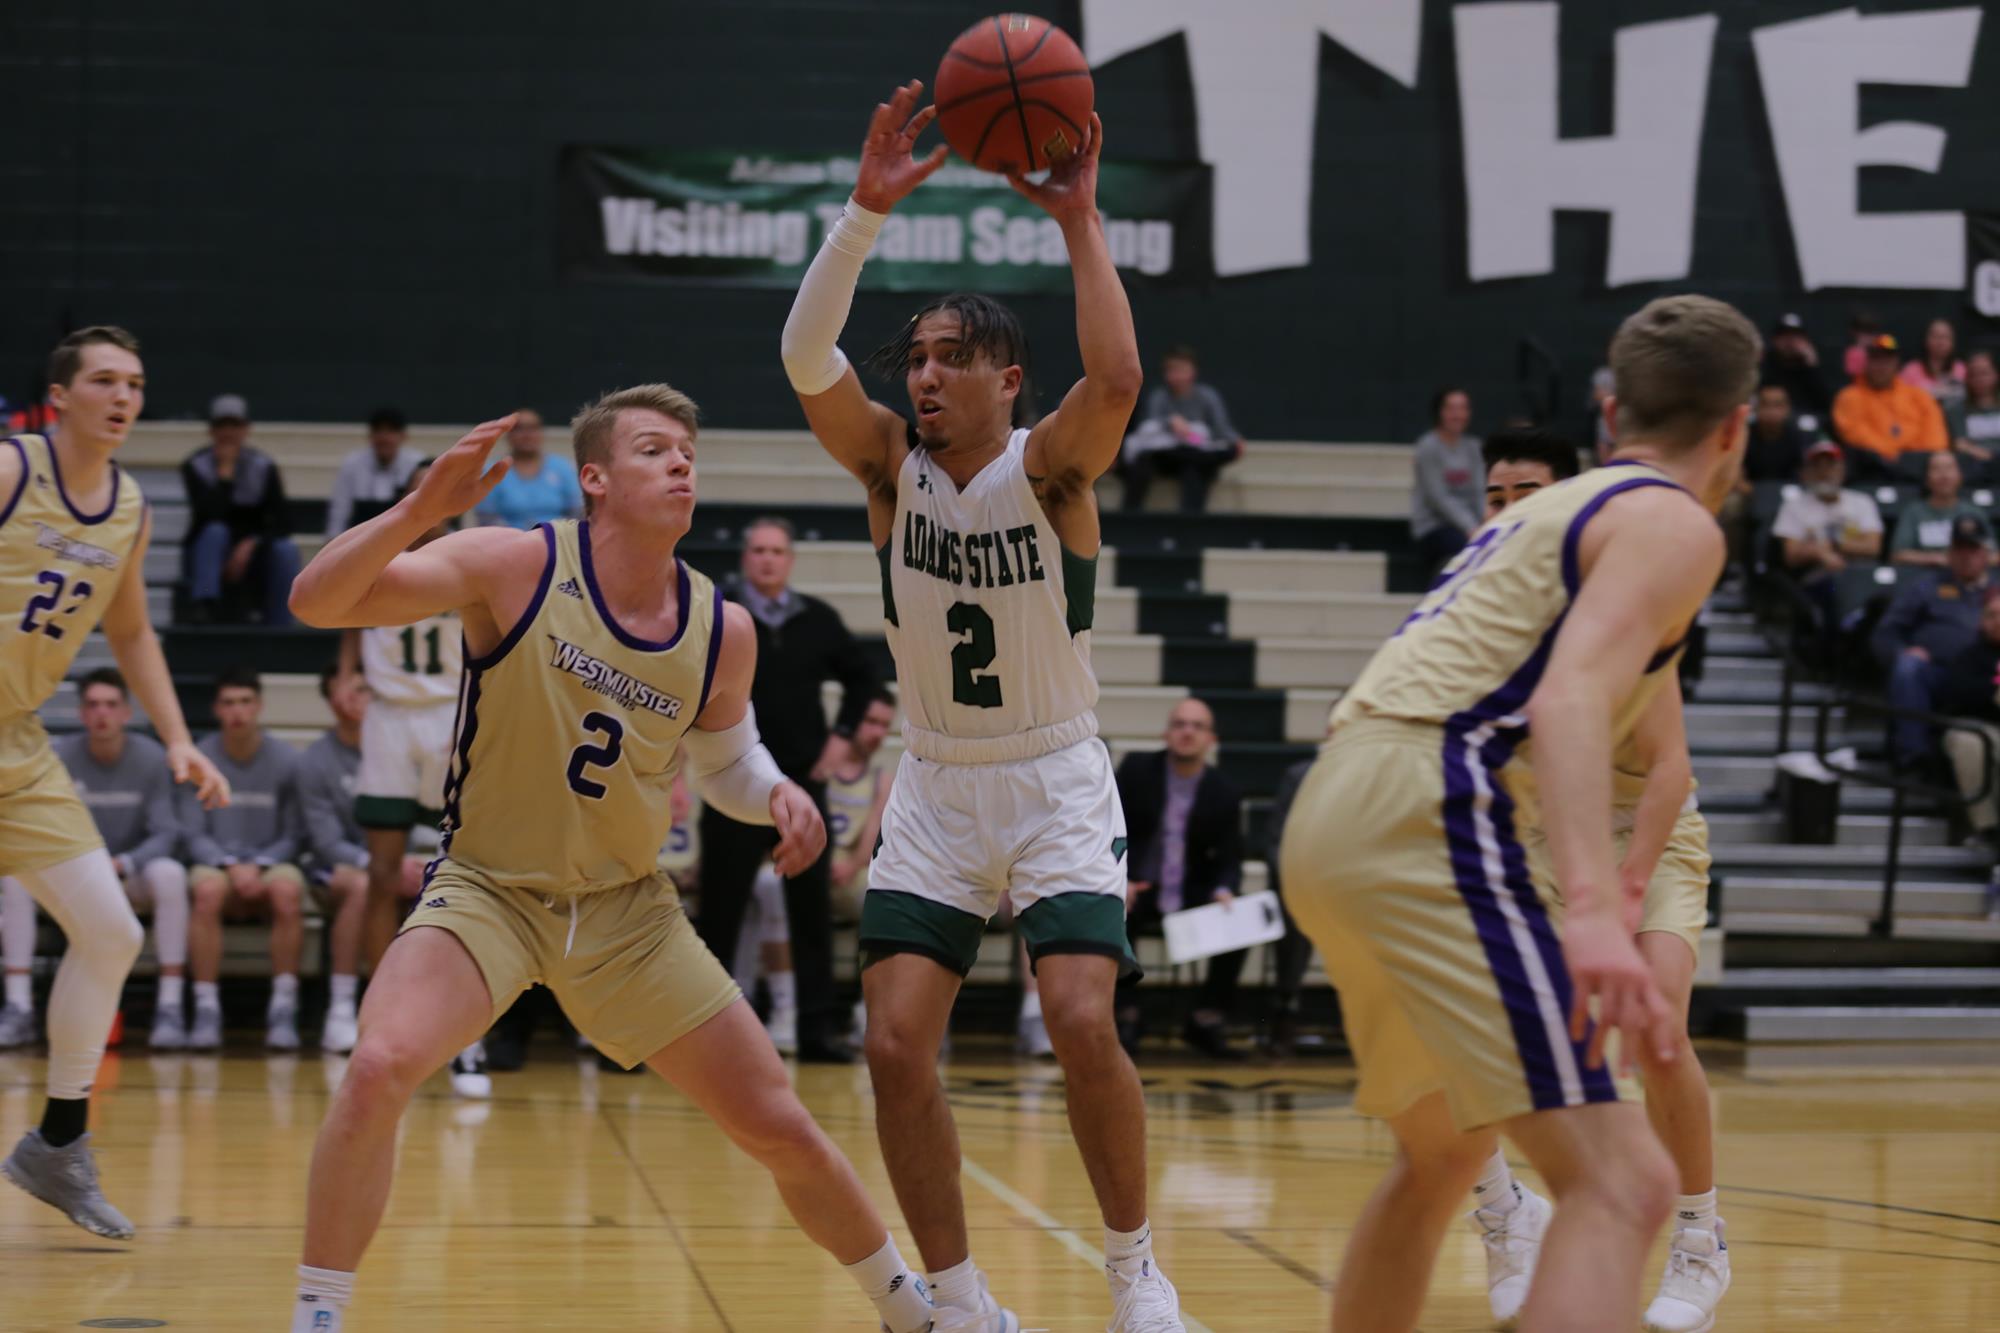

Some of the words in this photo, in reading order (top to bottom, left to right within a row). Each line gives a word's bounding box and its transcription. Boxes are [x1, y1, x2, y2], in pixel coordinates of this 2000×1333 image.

[1082, 0, 1982, 292] THE
[601, 196, 808, 266] Visiting
[815, 203, 962, 264] Tam
[970, 206, 1174, 275] Seang
[903, 510, 964, 586] ADAMS
[965, 523, 1046, 588] STATE
[399, 625, 443, 674] 11
[547, 634, 683, 720] WESTMINSTER
[946, 601, 1003, 709] 2
[566, 711, 624, 800] 2
